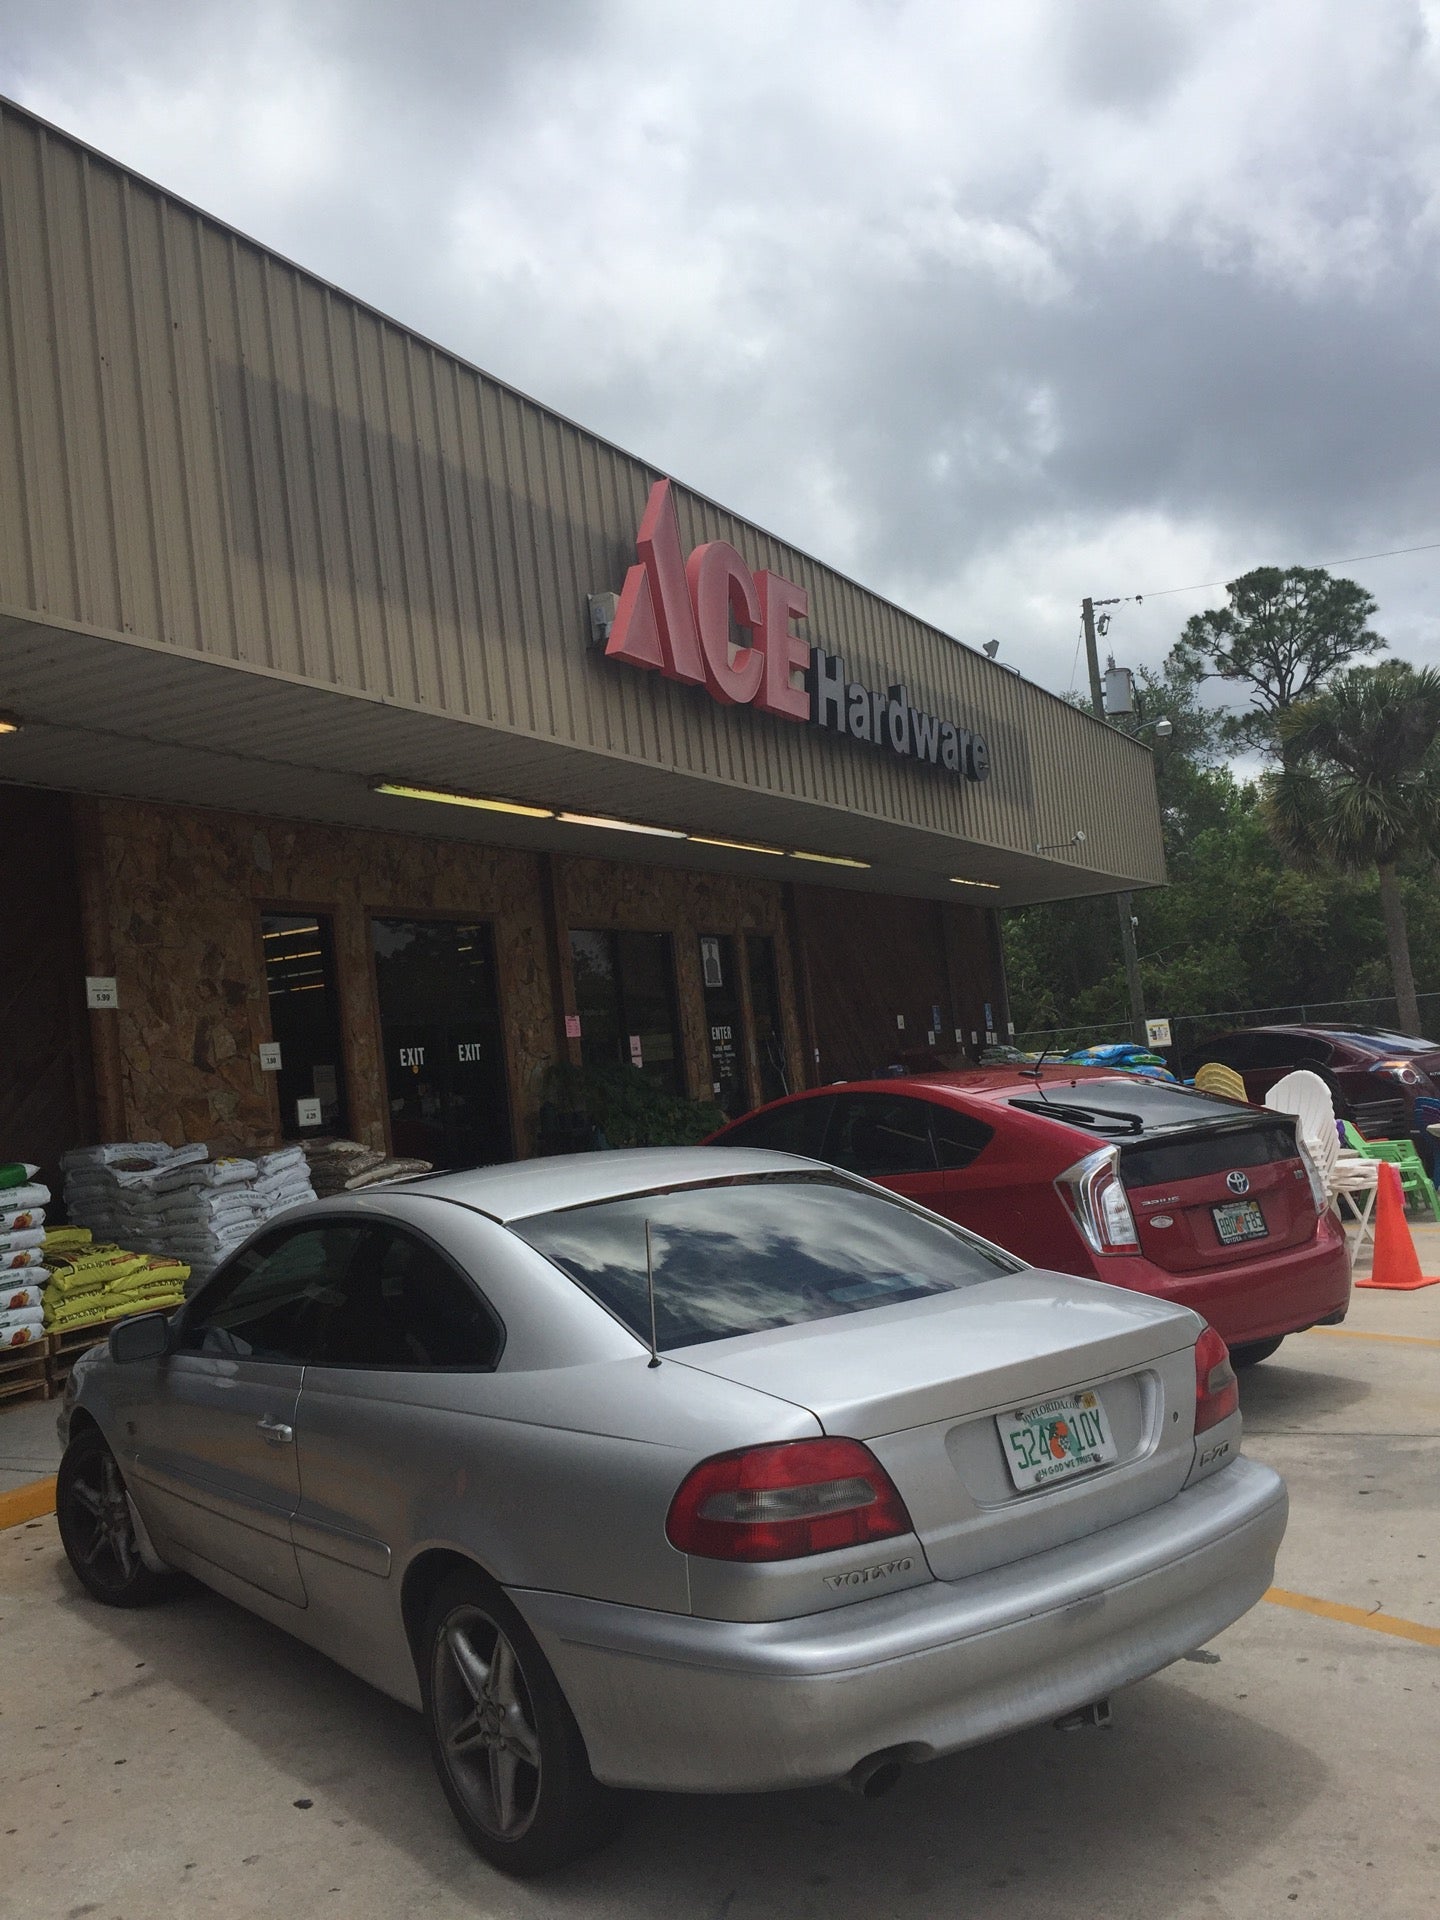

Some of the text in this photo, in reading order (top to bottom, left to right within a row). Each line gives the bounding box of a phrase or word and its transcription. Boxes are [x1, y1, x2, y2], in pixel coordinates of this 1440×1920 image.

[605, 478, 989, 782] ACE Hardware
[712, 1026, 732, 1040] ENTER
[400, 1047, 425, 1067] EXIT
[458, 1043, 481, 1062] EXIT
[1009, 1424, 1052, 1470] 524
[1048, 1463, 1064, 1475] GOD
[1064, 1460, 1075, 1469] WE
[1075, 1453, 1095, 1466] TRUST
[823, 1557, 914, 1591] VOLVO
